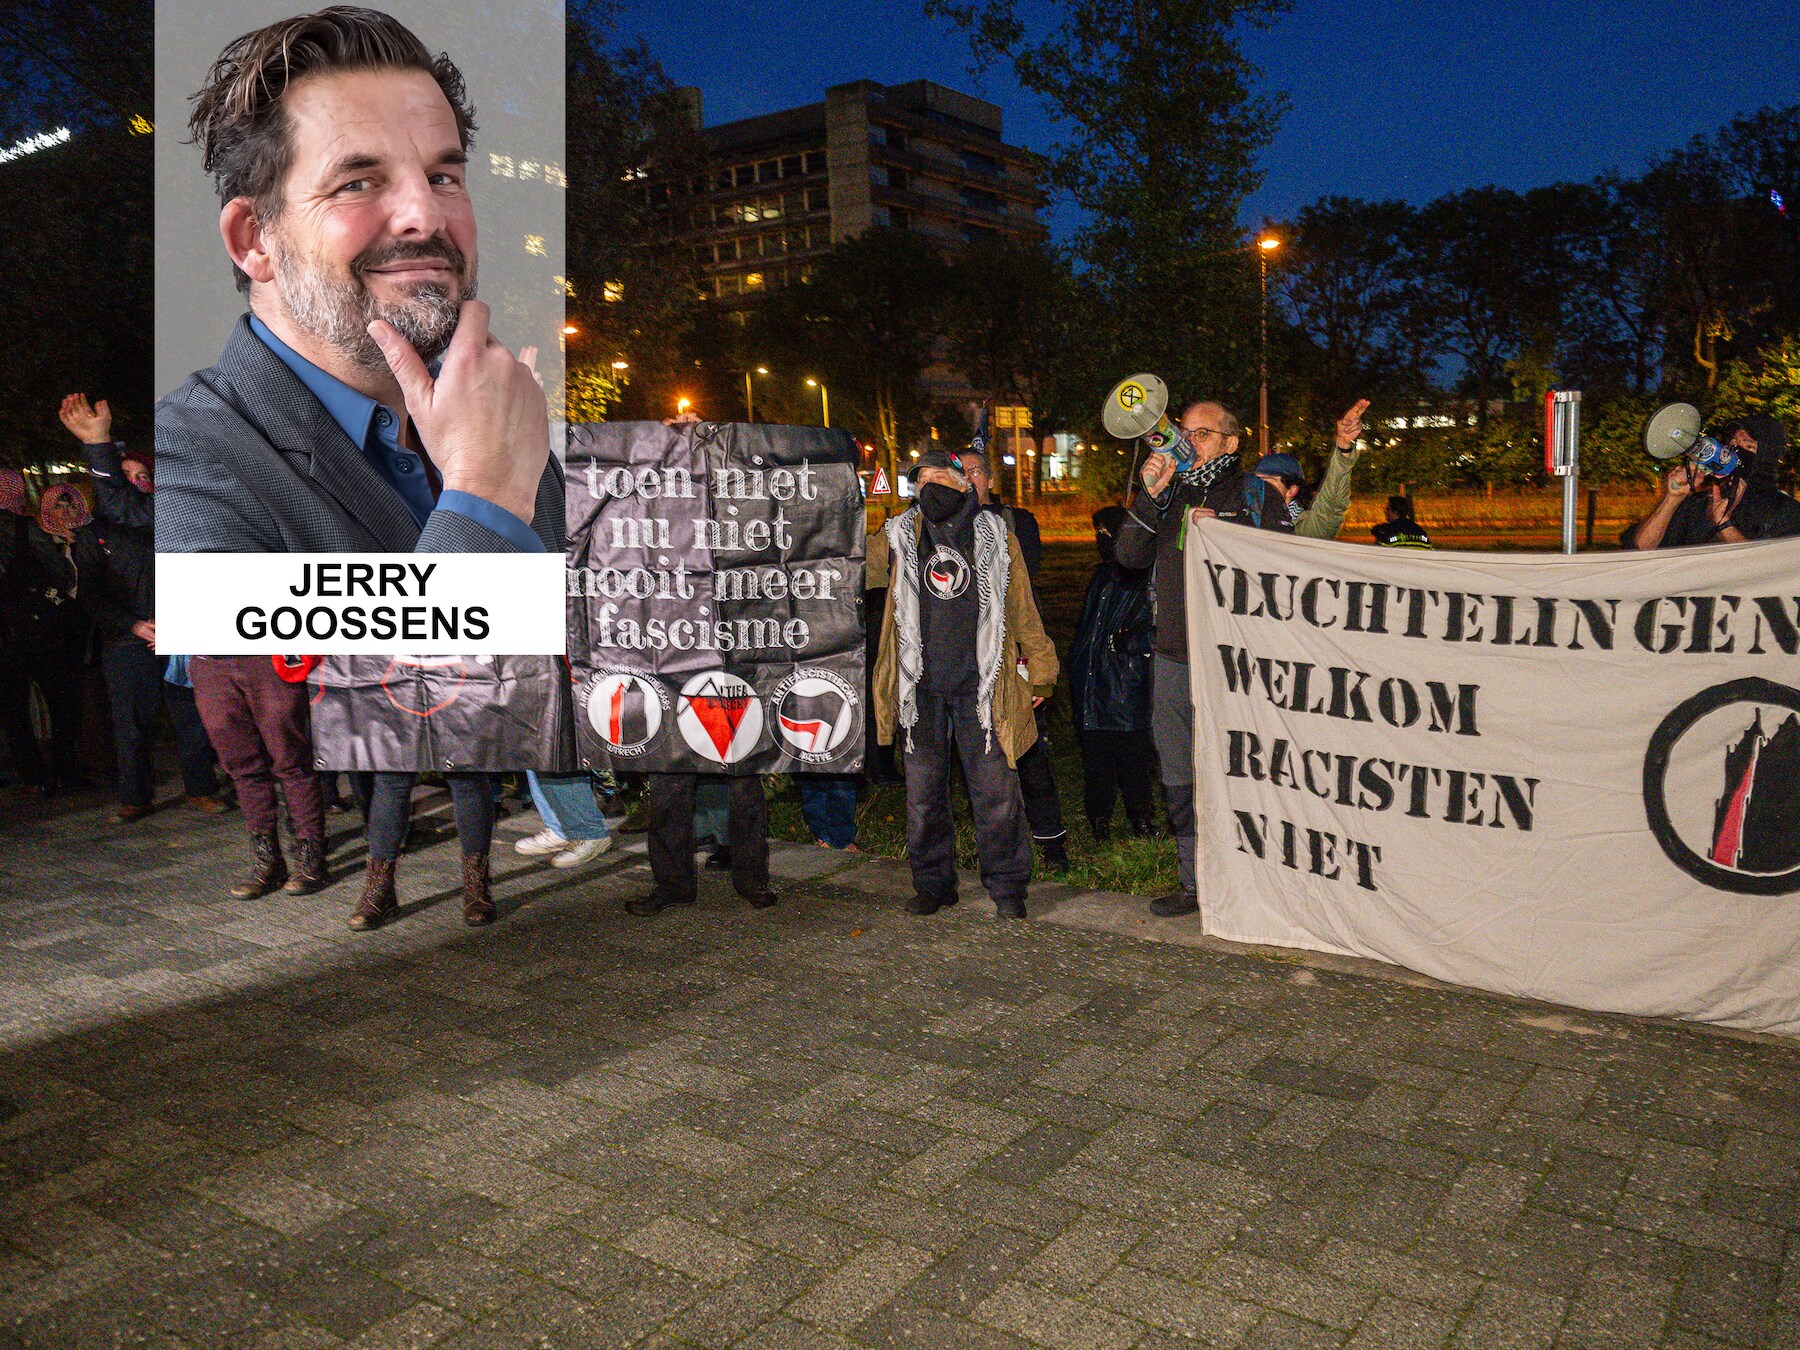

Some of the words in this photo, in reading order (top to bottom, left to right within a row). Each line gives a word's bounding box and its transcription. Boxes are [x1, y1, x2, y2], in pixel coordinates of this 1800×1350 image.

[583, 456, 697, 500] toen
[713, 454, 818, 501] niet
[609, 516, 674, 549] nu
[692, 505, 793, 552] niet
[566, 555, 695, 600] nooit
[713, 568, 842, 601] meer
[595, 602, 810, 651] fascisme
[1203, 559, 1800, 656] VLUCHTELINGEN
[771, 669, 859, 706] ANTIFASCISTISCHE
[1217, 643, 1482, 737] WELKOM
[606, 743, 647, 757] UTRECHT
[801, 751, 833, 762] ACTIE
[1225, 730, 1541, 831] RACISTEN
[1234, 808, 1382, 892] NIET
